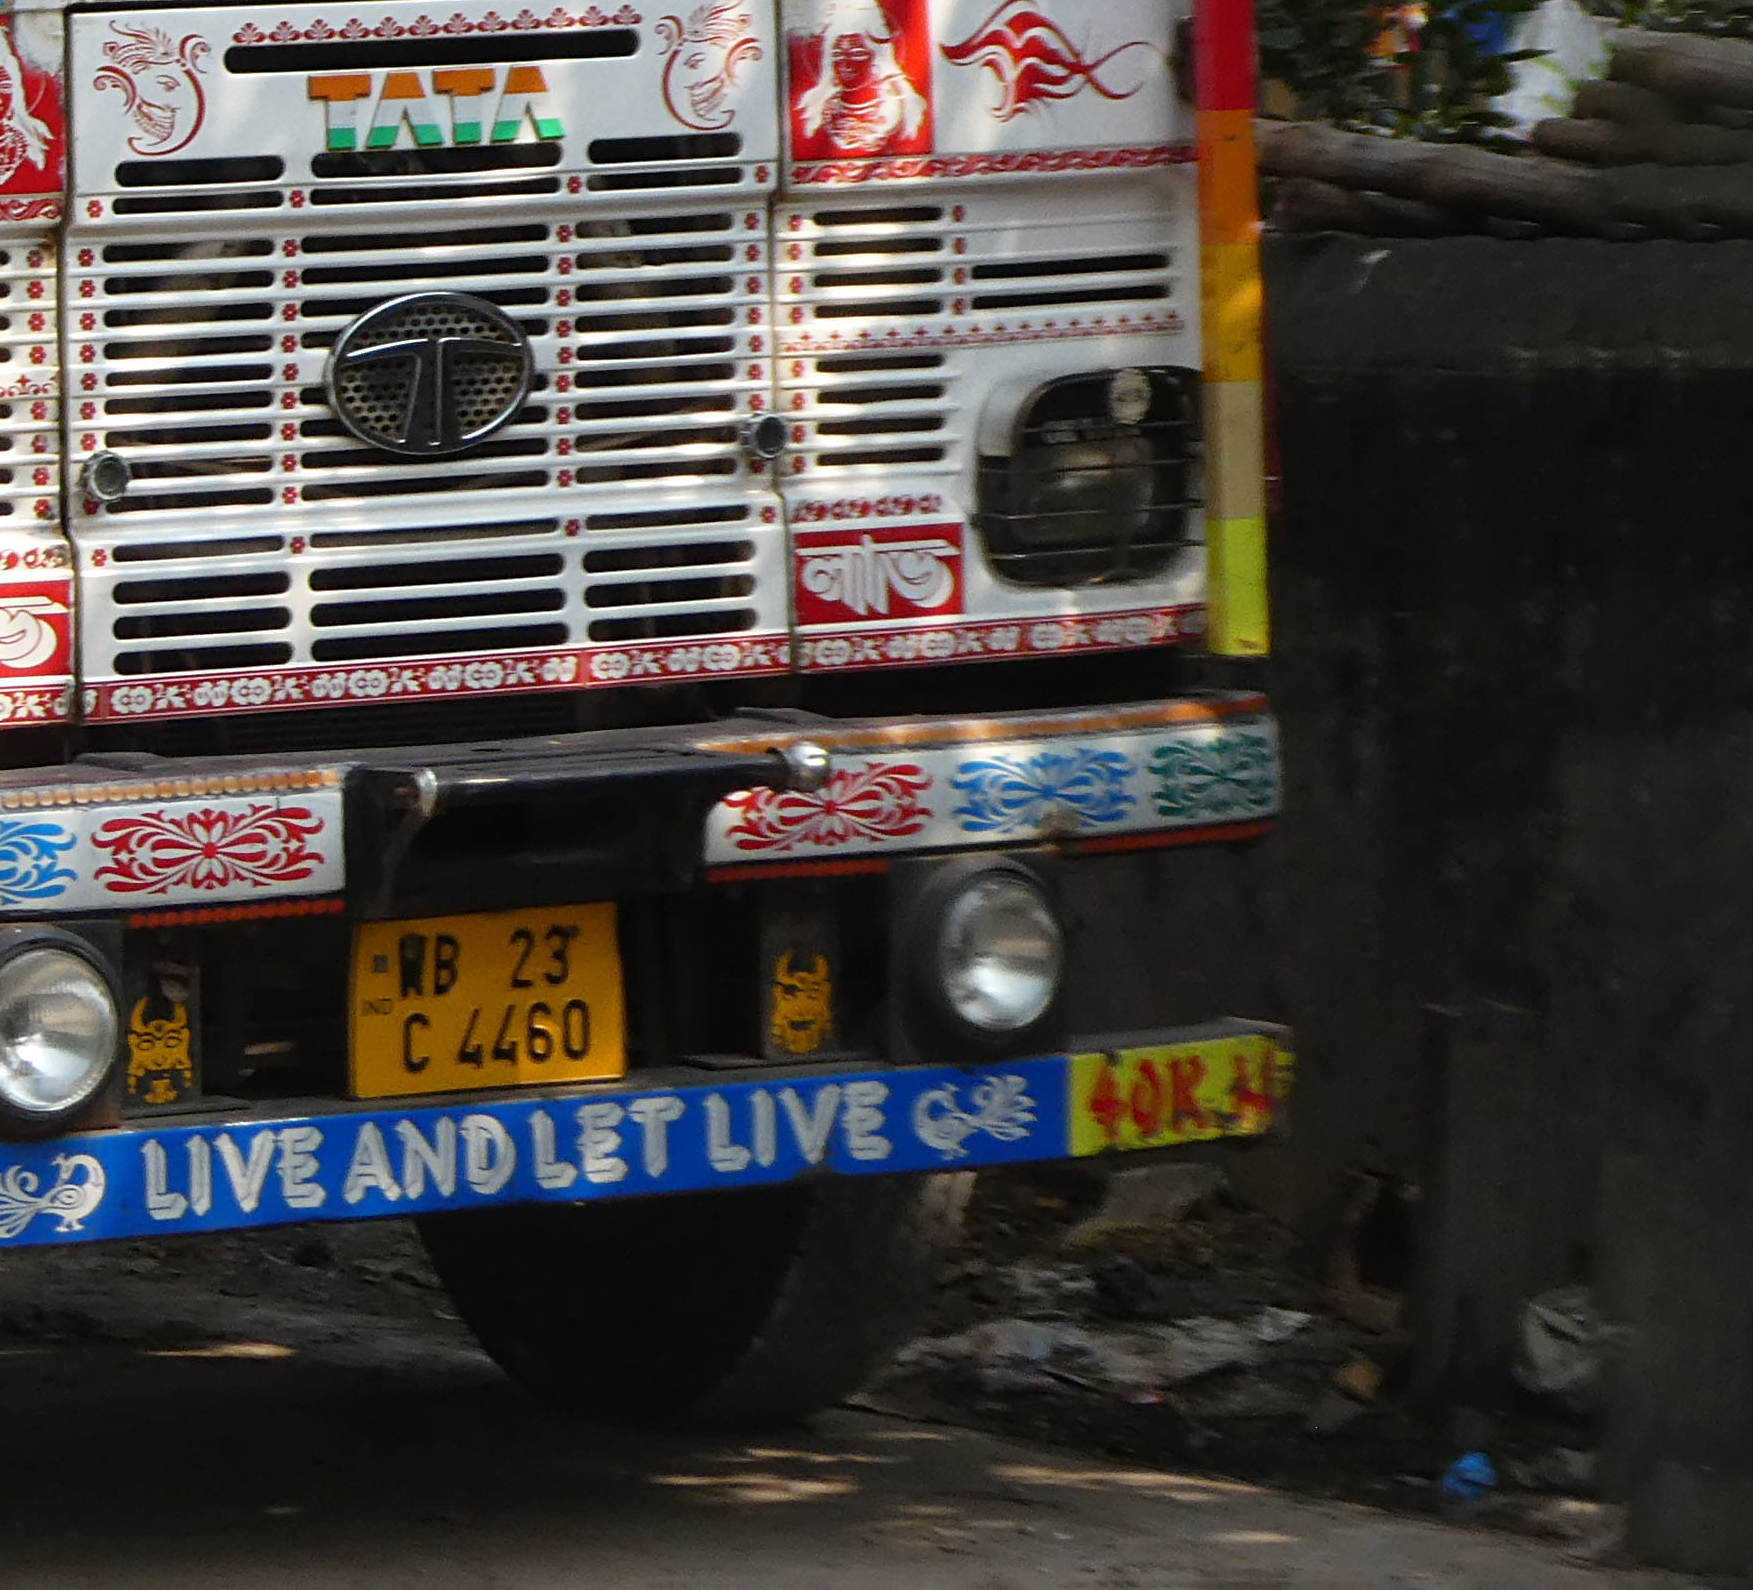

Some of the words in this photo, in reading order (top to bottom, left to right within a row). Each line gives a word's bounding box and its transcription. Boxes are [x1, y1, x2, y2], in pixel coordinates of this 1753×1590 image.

[306, 64, 568, 152] TATA
[398, 931, 460, 998] WB
[509, 924, 580, 991] 23
[458, 998, 592, 1070] 4460
[141, 1125, 325, 1222] LIVE
[343, 1113, 517, 1204] AND
[529, 1094, 686, 1190] LET
[704, 1080, 893, 1173] LIVE
